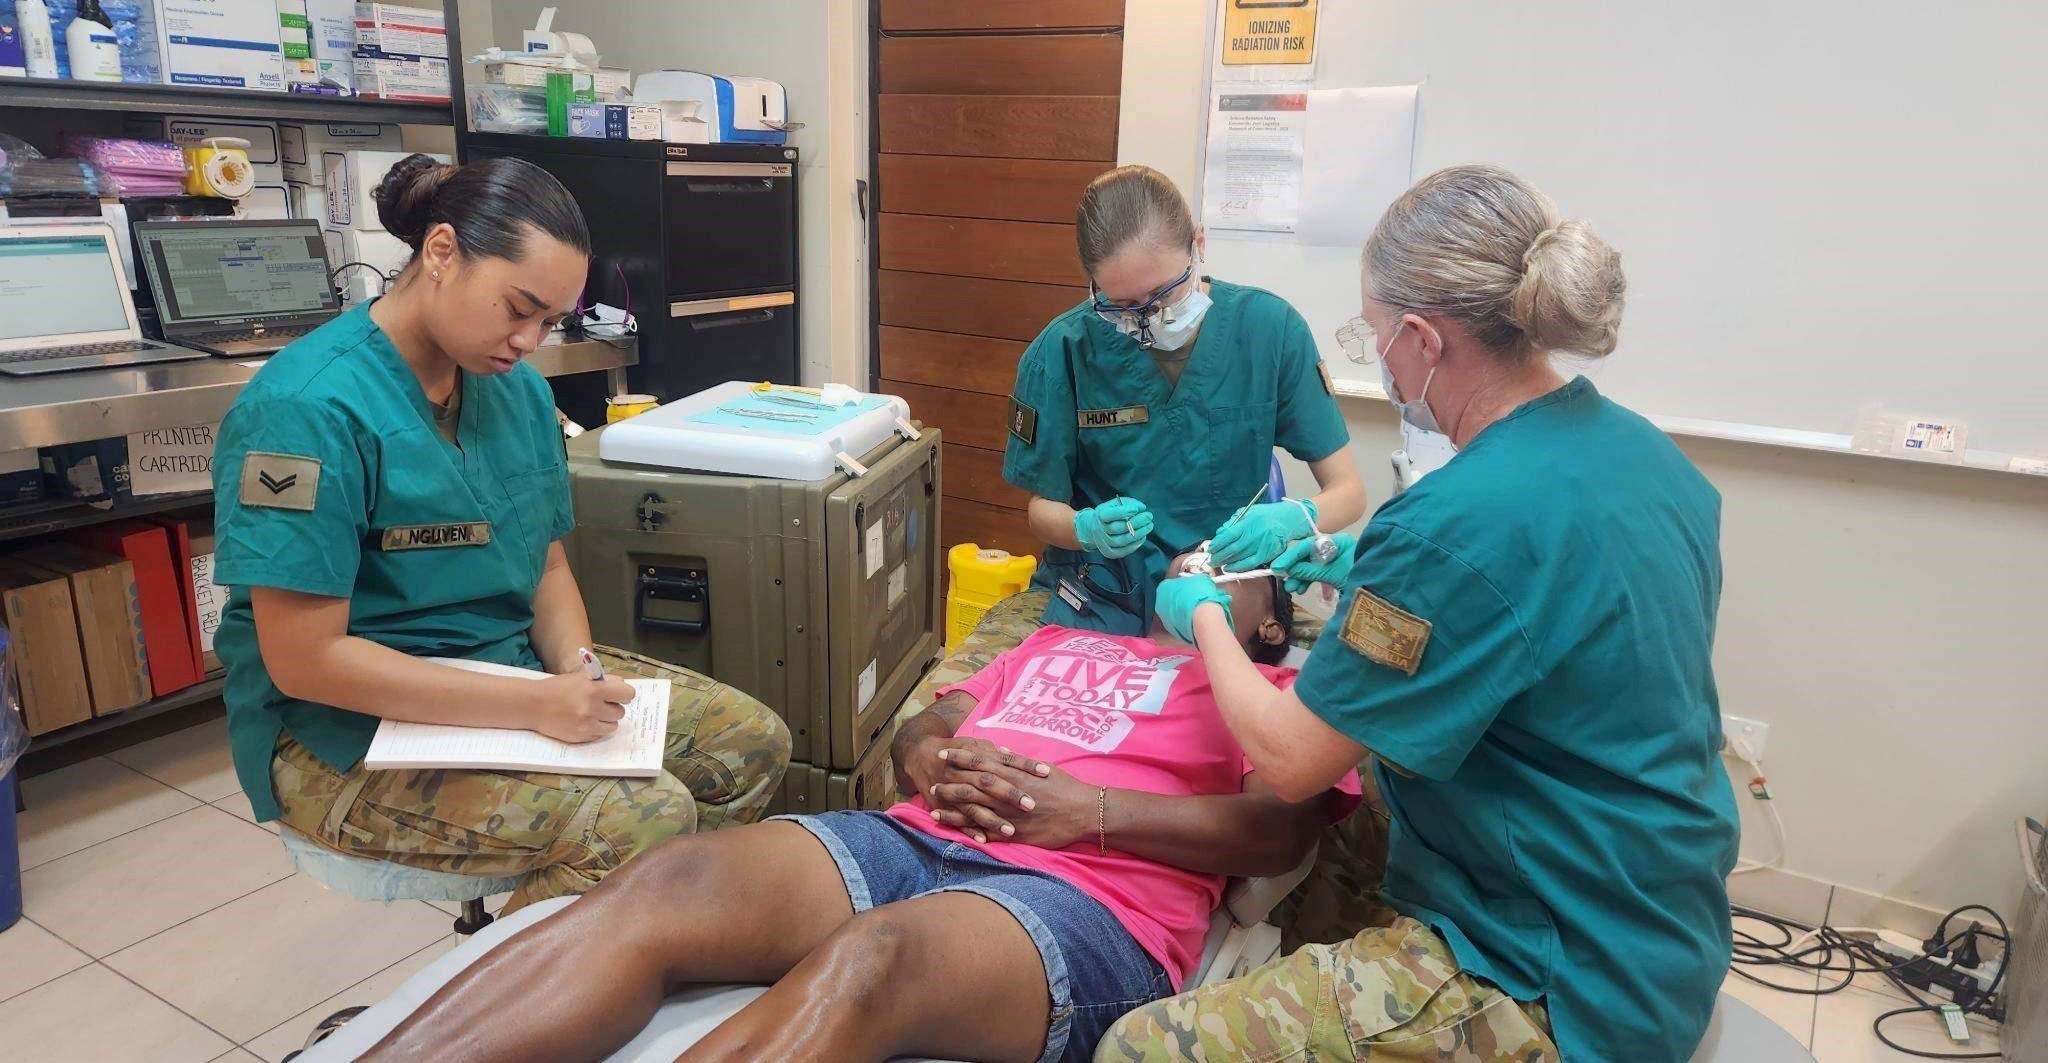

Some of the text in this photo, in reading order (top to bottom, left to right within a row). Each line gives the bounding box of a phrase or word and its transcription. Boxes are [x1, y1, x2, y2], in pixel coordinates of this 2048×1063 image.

[1249, 20, 1290, 34] IONIZING
[1232, 36, 1304, 51] RADIATION RISK
[1086, 411, 1118, 425] HUNT
[143, 426, 214, 446] PRINTER
[408, 525, 468, 545] NGUYEN
[191, 555, 214, 607] BRACKET
[1033, 656, 1157, 692] LIVE
[1038, 680, 1144, 709] TODAY
[998, 711, 1102, 745] TOMORROW
[1096, 715, 1118, 736] FOR
